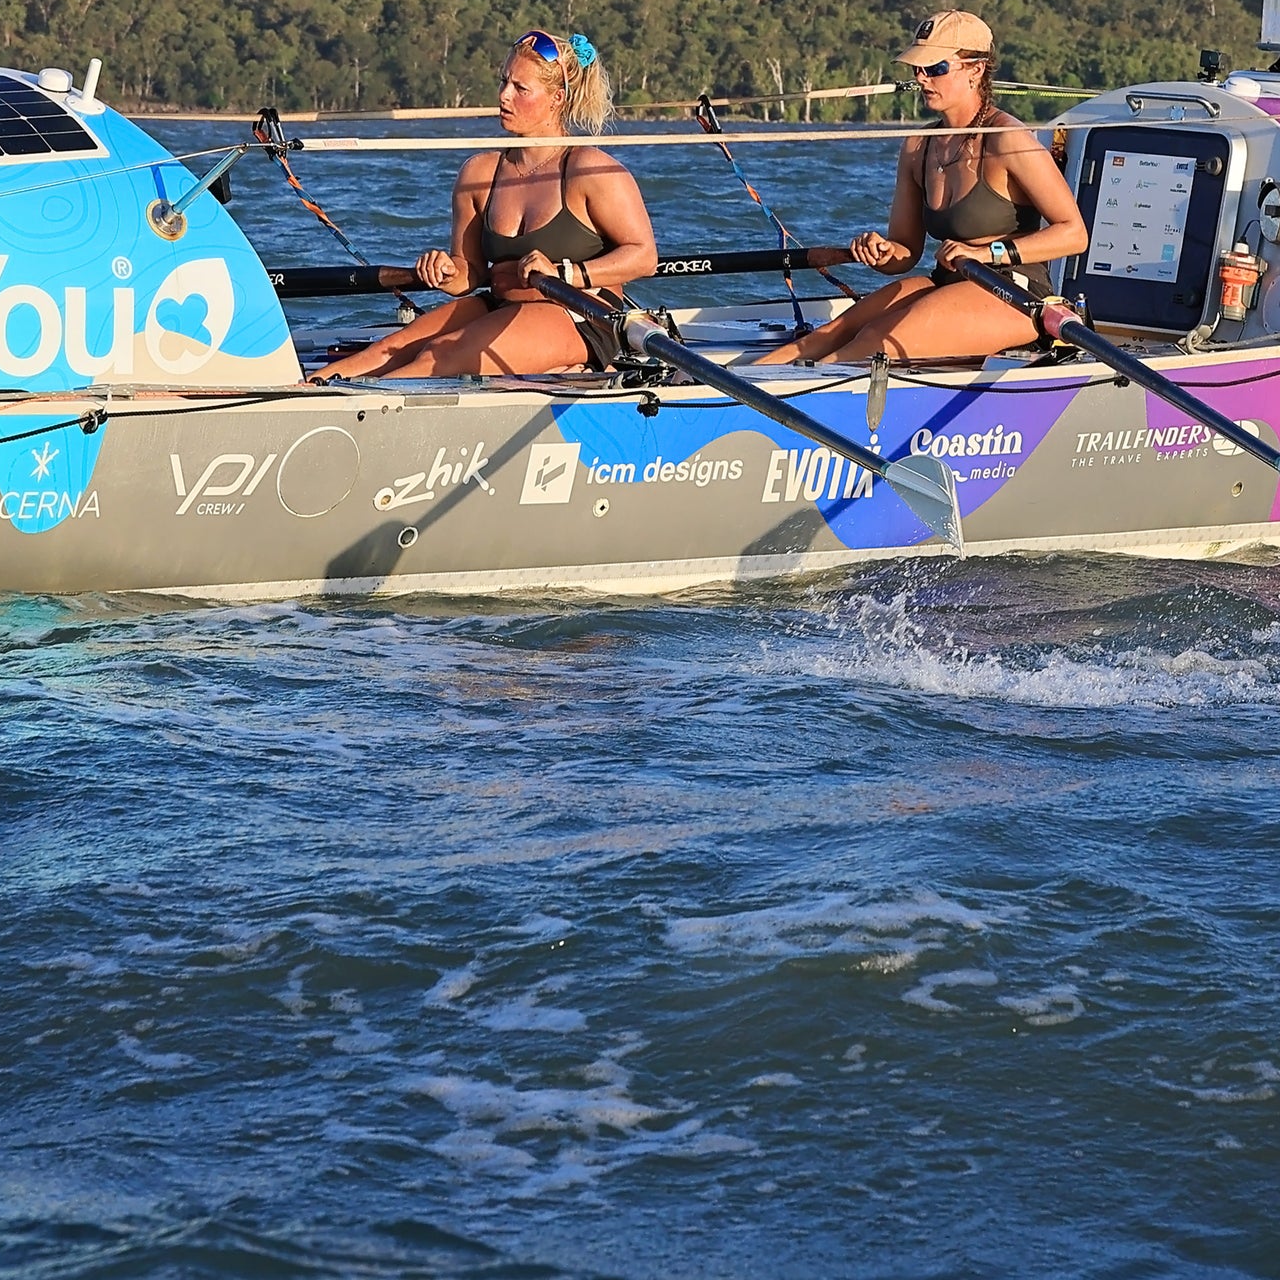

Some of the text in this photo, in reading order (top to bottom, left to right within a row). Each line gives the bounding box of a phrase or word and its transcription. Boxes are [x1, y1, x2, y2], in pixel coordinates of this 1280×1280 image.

[1075, 424, 1212, 453] TRAILFINDERS
[1071, 456, 1095, 468] THE
[1156, 447, 1209, 461] EXPERTS
[586, 456, 744, 488] icm designs
[970, 461, 1016, 480] media
